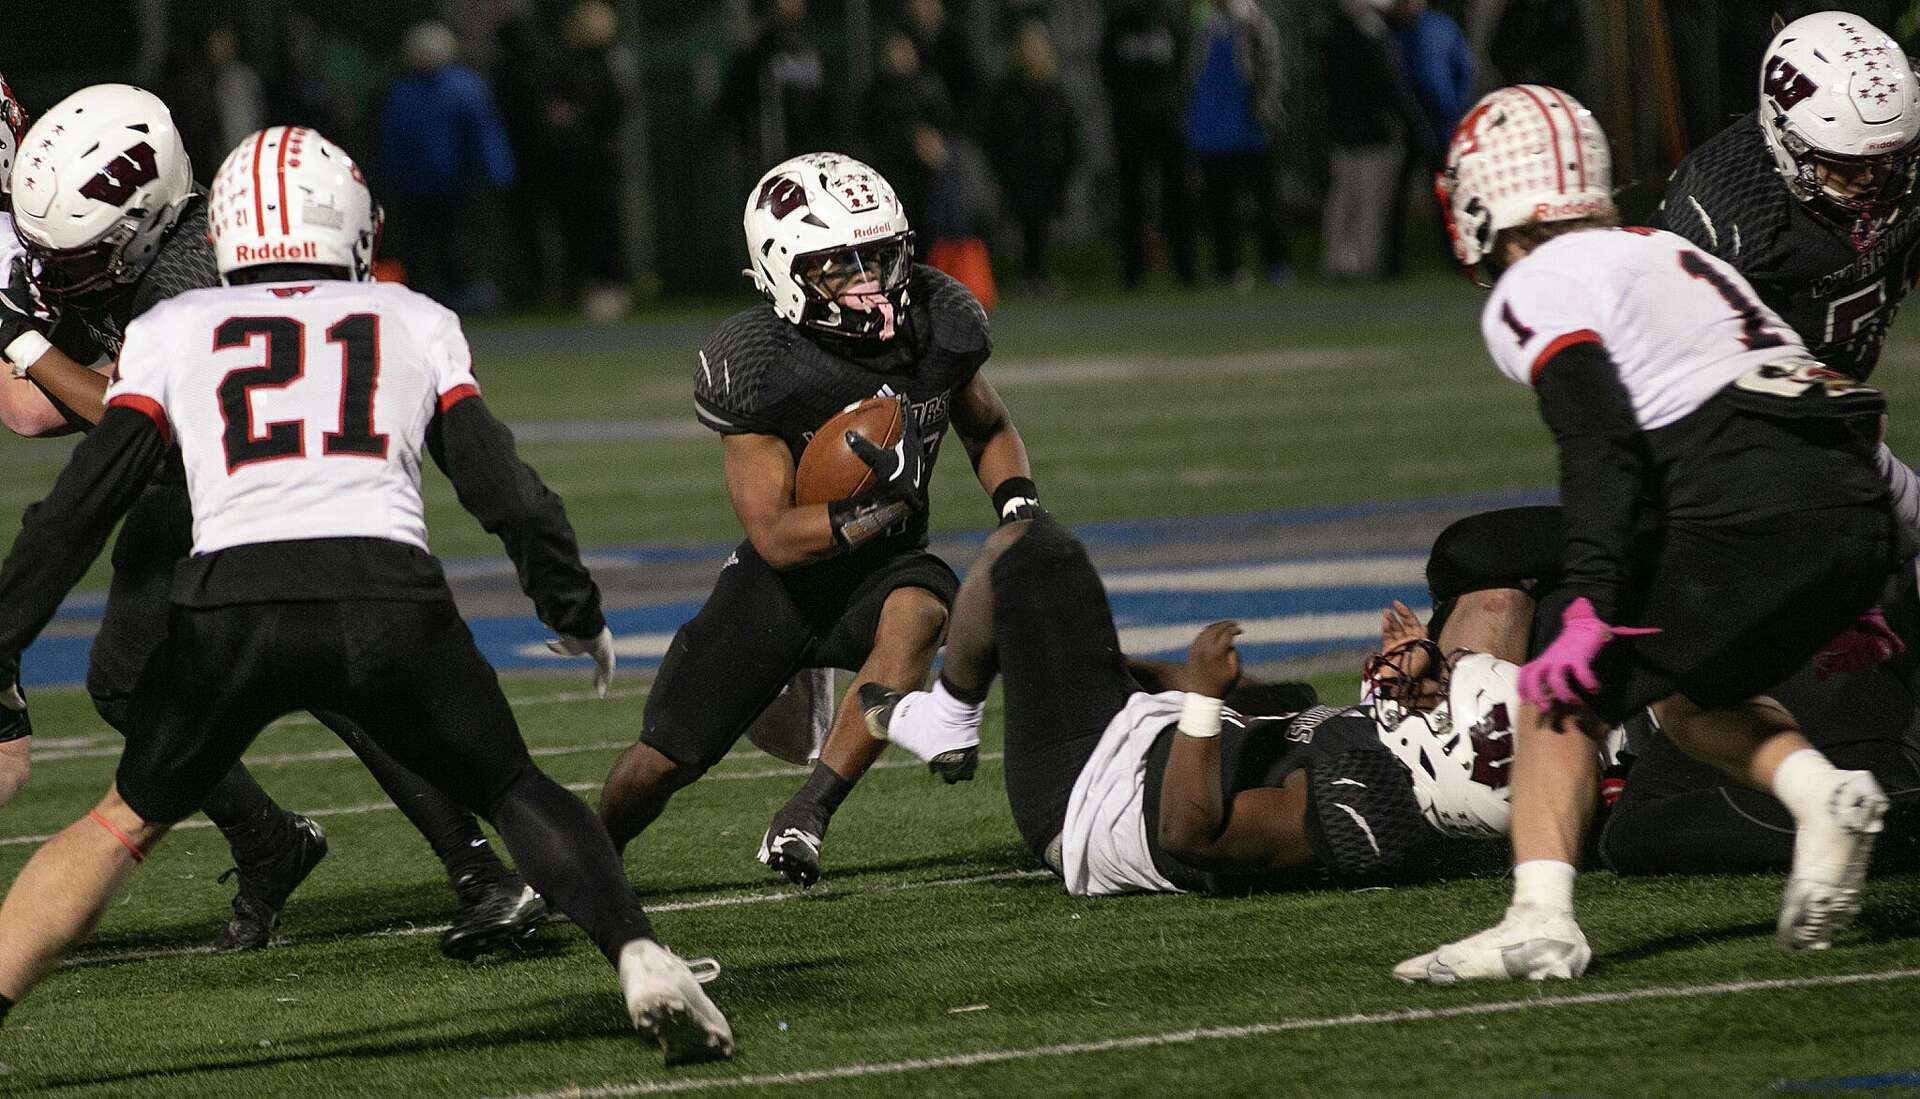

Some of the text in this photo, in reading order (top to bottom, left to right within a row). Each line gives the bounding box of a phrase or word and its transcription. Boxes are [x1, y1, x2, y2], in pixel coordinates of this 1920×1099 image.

[235, 242, 318, 262] Riddell
[852, 222, 892, 239] Riddell
[1501, 299, 1535, 349] 1
[1678, 250, 1786, 351] 1
[212, 313, 390, 477] 21
